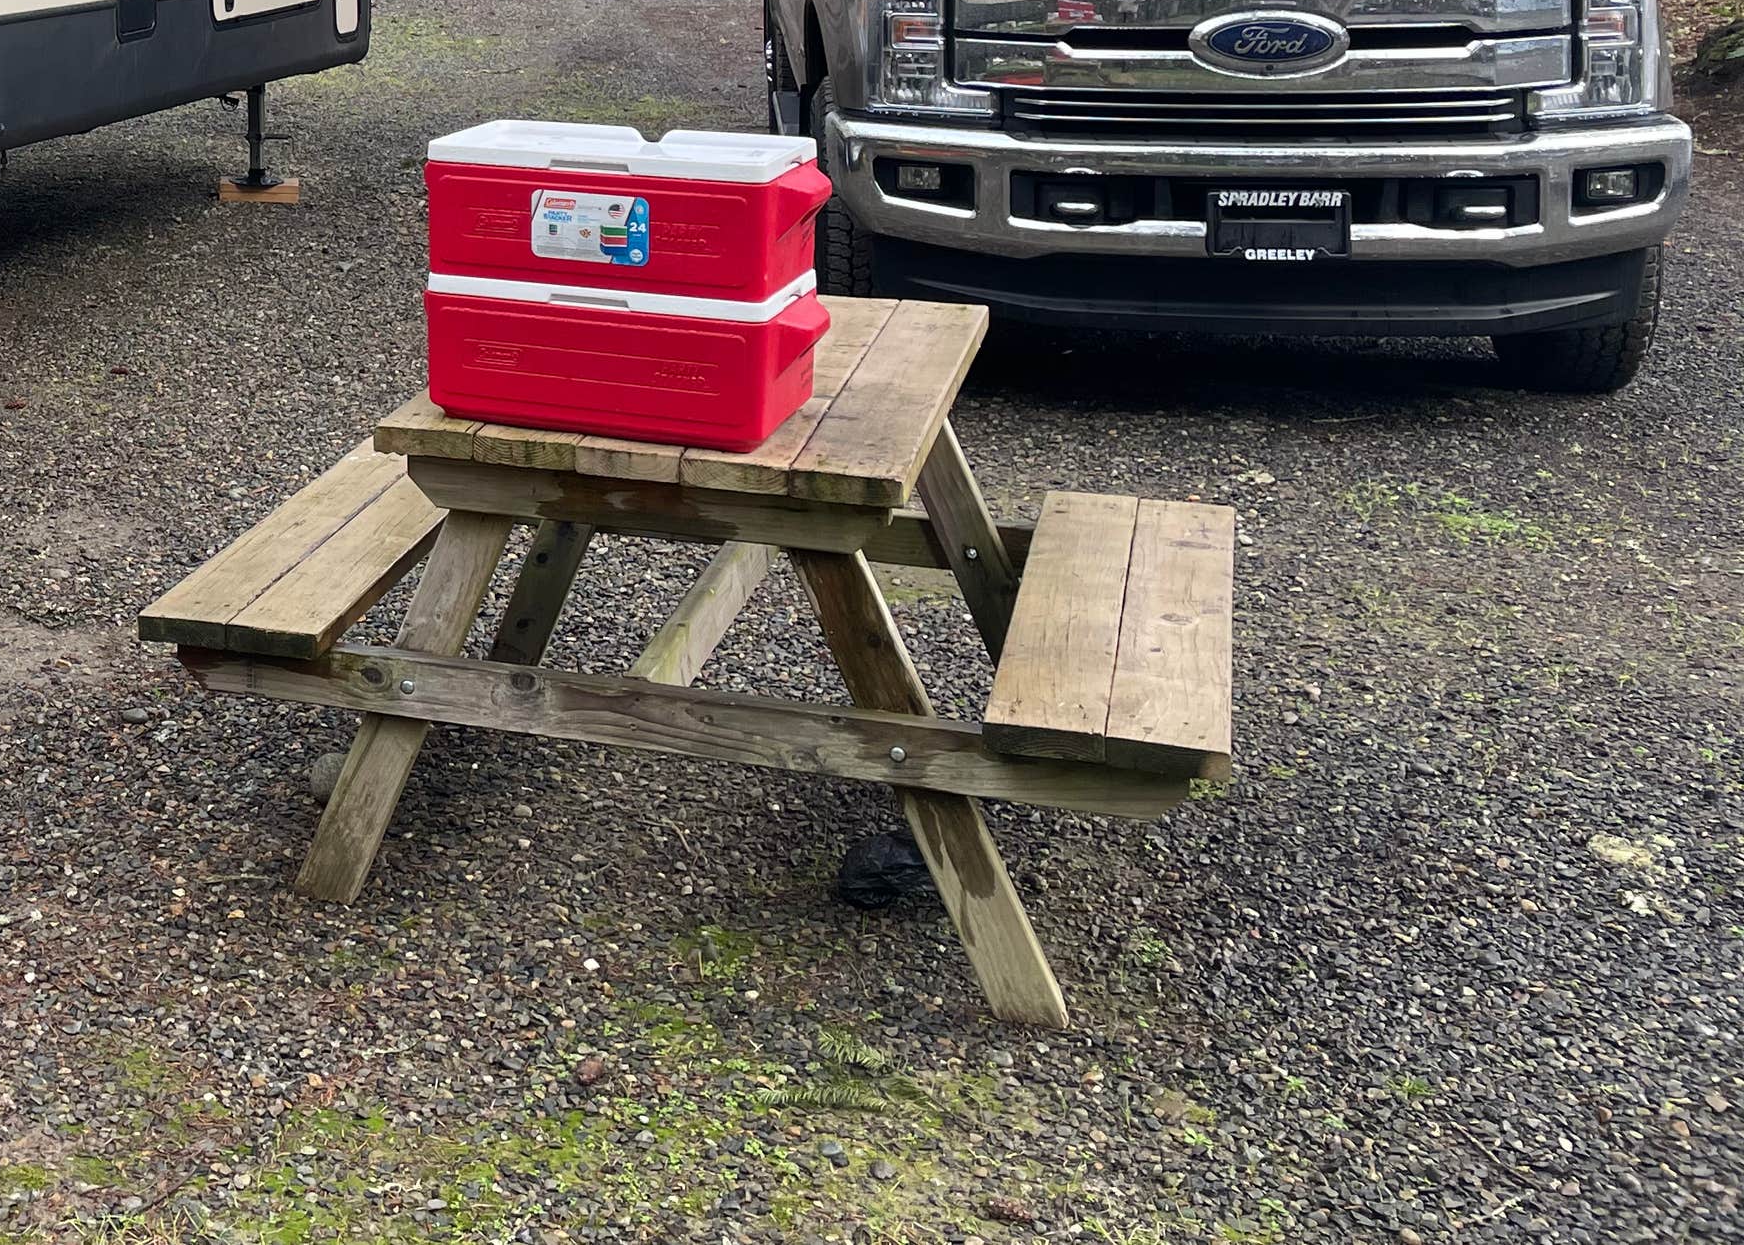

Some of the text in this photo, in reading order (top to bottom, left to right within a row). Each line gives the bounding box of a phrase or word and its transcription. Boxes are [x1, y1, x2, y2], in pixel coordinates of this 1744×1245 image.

[1234, 26, 1309, 54] Ford
[1218, 191, 1343, 207] SPRADLEY BARR
[629, 221, 647, 234] 24
[1244, 249, 1316, 261] GREELEY
